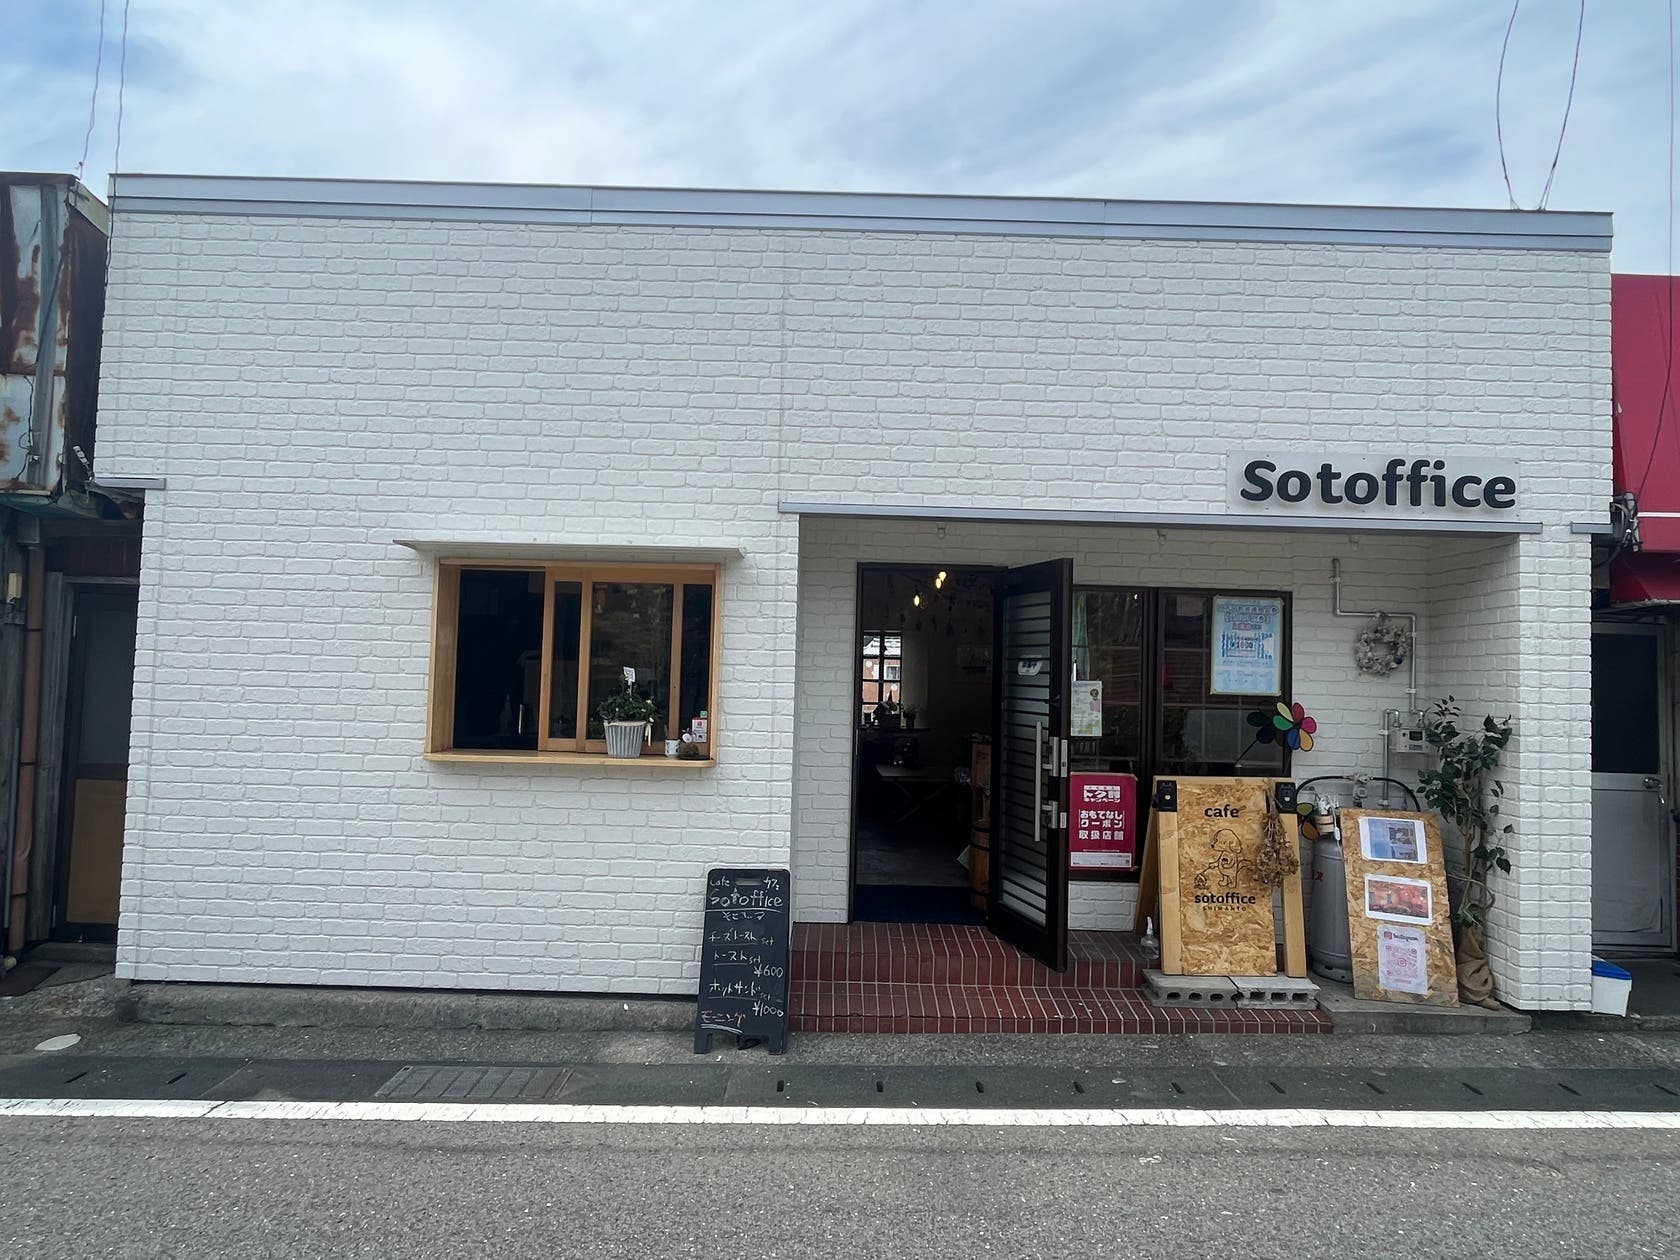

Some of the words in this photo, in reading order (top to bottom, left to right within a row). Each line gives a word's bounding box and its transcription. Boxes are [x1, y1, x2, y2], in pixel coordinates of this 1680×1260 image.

[1240, 458, 1516, 508] Sotoffice
[1080, 810, 1123, 820] おもてなし
[1204, 804, 1240, 818] cafe
[1080, 820, 1123, 828] クーポン
[1194, 892, 1257, 905] sotoffice
[714, 950, 748, 961] トースト
[753, 964, 784, 978] ¥600
[752, 1001, 785, 1018] ¥1000
